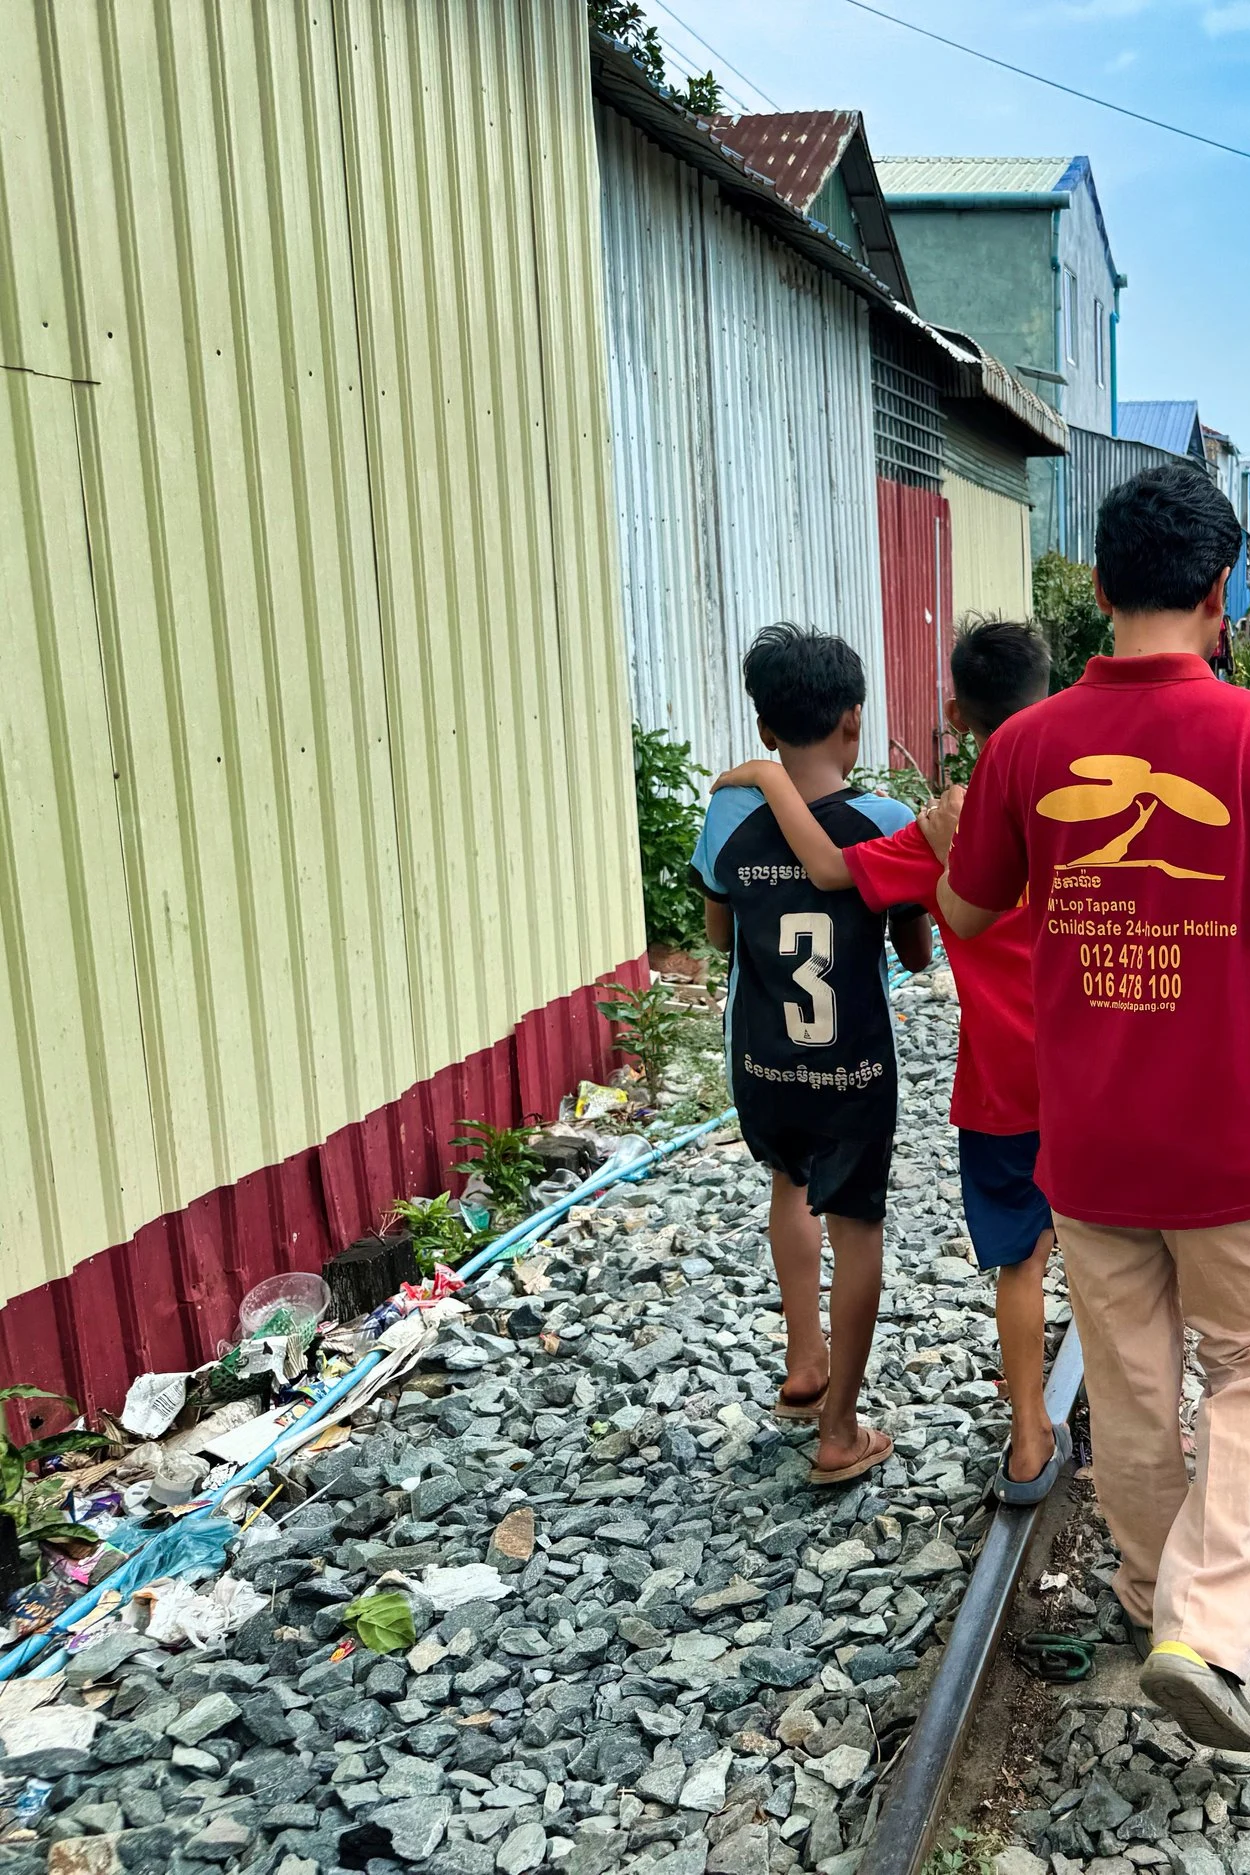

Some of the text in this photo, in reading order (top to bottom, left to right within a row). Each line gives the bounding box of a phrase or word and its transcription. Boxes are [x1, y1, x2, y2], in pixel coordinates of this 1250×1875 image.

[1048, 898, 1136, 915] M'Lop Tapang
[1048, 920, 1122, 937] ChildSafe
[1183, 920, 1237, 937] Hotline
[1080, 943, 1180, 970] 012 478 100
[779, 912, 838, 1047] 3
[1083, 971, 1181, 999] 016 478 100
